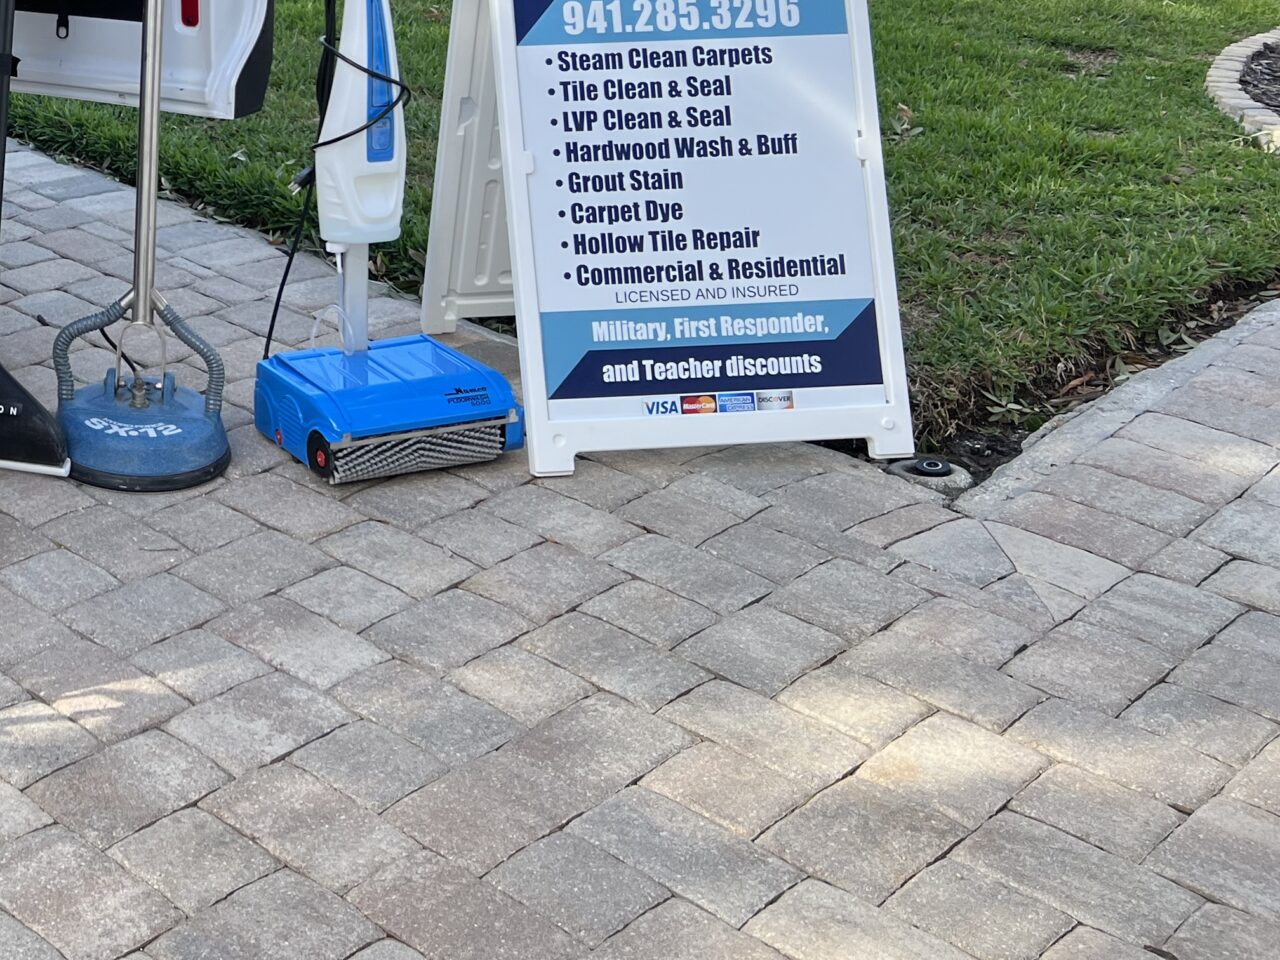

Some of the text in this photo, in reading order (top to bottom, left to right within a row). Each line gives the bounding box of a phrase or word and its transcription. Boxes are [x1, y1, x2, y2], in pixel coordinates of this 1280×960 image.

[557, 45, 773, 72] Steam Clean Carpets
[559, 75, 732, 101] Tile Clean & Seal
[562, 105, 732, 132] LVP Clean & Seal
[565, 133, 798, 163] Hardwood Wash & Buff
[568, 169, 684, 193] Grout Stain
[570, 200, 684, 225] Carpet Dye
[573, 227, 760, 255] Hollow Tile Repair
[576, 253, 846, 286] Commercial & Residential
[615, 283, 799, 304] LICENSED AND INSURED
[591, 312, 829, 342] Military, First Responder,
[602, 353, 822, 383] and Teacher discounts
[645, 401, 716, 415] VISA MasterCard
[719, 396, 751, 404] AMERICAN
[758, 395, 791, 403] DISCOVER
